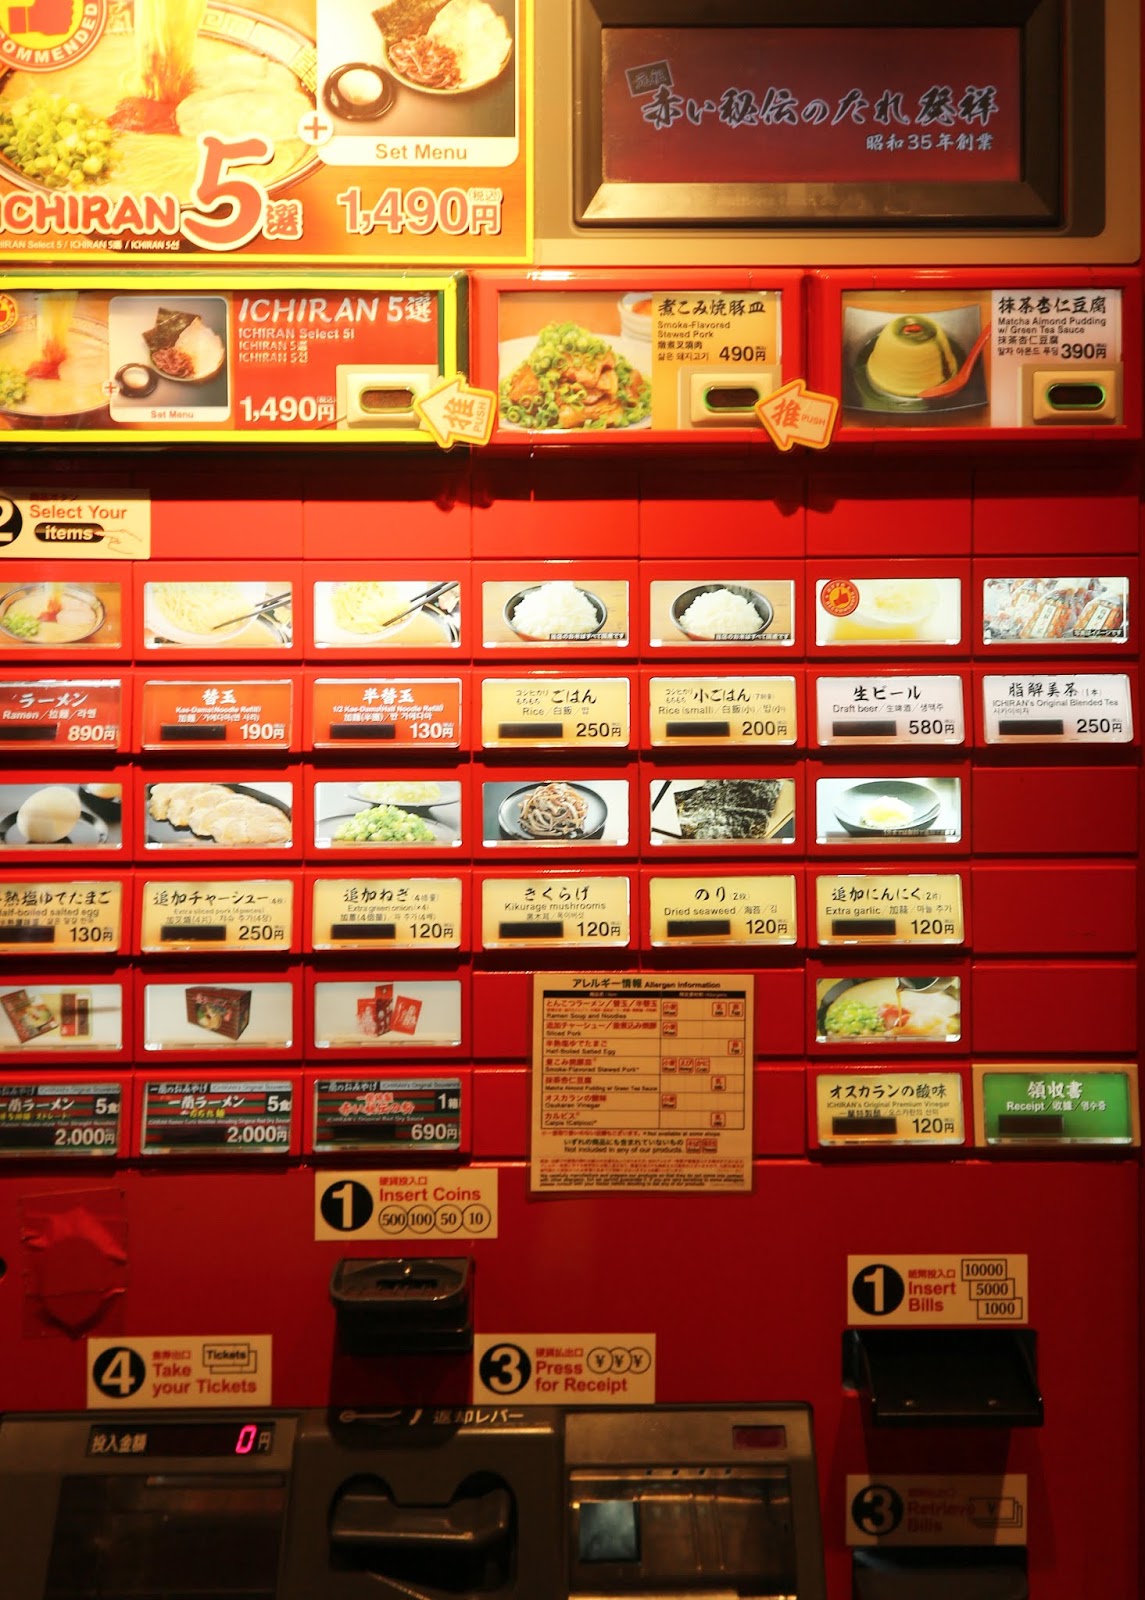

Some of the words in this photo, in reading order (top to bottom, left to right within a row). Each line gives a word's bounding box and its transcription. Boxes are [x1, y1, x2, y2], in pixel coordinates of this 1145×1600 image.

[865, 133, 994, 151] 昭和35年創業
[376, 143, 408, 160] Set
[415, 143, 467, 160] Menu
[0, 192, 180, 234] CHIRAN
[337, 186, 502, 235] 1,490円
[28, 240, 54, 249] Select
[238, 297, 379, 323] ICHIRAN
[387, 294, 432, 323] 5選
[658, 298, 767, 317] 煮こみ焼豚皿
[998, 296, 1106, 314] 抹茶杏仁豆腐
[658, 321, 731, 329] Smoke-Flavored
[998, 317, 1030, 325] Matcha
[1032, 317, 1067, 326] Almond
[1069, 317, 1106, 327] Pudding
[238, 328, 295, 339] ICHIRAN
[299, 328, 340, 339] Select
[1010, 326, 1037, 334] Green
[1040, 326, 1055, 334] Tea
[1057, 326, 1085, 334] Sauce
[239, 341, 287, 351] ICHIRAN
[719, 345, 766, 361] 490円
[1061, 343, 1107, 359] 390円
[239, 352, 287, 363] ICHIRAN
[151, 411, 166, 419] Set
[169, 411, 194, 419] Menu
[239, 395, 335, 422] 1,490円
[771, 399, 801, 429] 推
[473, 402, 487, 433] PUSH
[800, 414, 826, 426] PUSH
[30, 504, 82, 519] Select
[88, 505, 128, 519] Your
[45, 525, 94, 540] items
[19, 692, 88, 708] ラーメン
[202, 688, 237, 705] 替玉
[362, 687, 415, 705] 半替玉
[551, 689, 597, 704] ごはん
[693, 688, 750, 703] 小ごはん
[853, 685, 921, 701] 生ビール
[522, 707, 545, 716] Rice
[658, 706, 680, 715] Rice
[682, 705, 714, 714] (small)
[833, 704, 855, 713] Draft
[858, 704, 878, 713] beer
[1036, 700, 1068, 708] Original
[2, 710, 39, 719] Ramen
[67, 725, 115, 741] 890円
[240, 723, 284, 740] 190円
[410, 722, 453, 739] 130円
[576, 722, 621, 737] 250円
[742, 721, 787, 736] 200円
[909, 720, 955, 735] 580円
[1077, 719, 1122, 733] 250円
[0, 890, 112, 907] 熟塩ゆでたまご
[153, 890, 268, 906] 追加チャーシュー
[343, 887, 409, 903] 追加ねぎ
[524, 886, 590, 901] きくらげ
[695, 886, 725, 901] のり
[832, 887, 921, 902] 追加にんにく
[81, 910, 99, 918] egg
[368, 905, 390, 913] green
[505, 903, 547, 911] Kikurage
[550, 902, 606, 910] mushrooms
[664, 907, 690, 916] Dried
[693, 907, 736, 915] seaweed
[826, 907, 851, 915] Extra
[854, 907, 880, 916] garlic
[70, 927, 113, 942] 130円
[239, 926, 284, 940] 250円
[410, 923, 453, 938] 120円
[577, 922, 620, 937] 120円
[746, 920, 788, 934] 120円
[911, 920, 954, 934] 120円
[572, 978, 642, 988] アレルギー情報
[830, 1084, 947, 1099] オスカランの酸味
[1028, 1081, 1083, 1099] 領収書
[924, 1101, 950, 1109] Vinegar
[1007, 1102, 1045, 1112] Receipt
[412, 1123, 457, 1140] 690円
[913, 1118, 954, 1134] 120円
[55, 1128, 115, 1145] 2,000円
[227, 1126, 287, 1143] 2,000円
[379, 1188, 428, 1202] Insert
[433, 1187, 481, 1201] Coins
[332, 1183, 354, 1229] 1
[382, 1214, 406, 1226] 500
[410, 1214, 433, 1226] 100
[440, 1213, 457, 1225] 50
[469, 1213, 483, 1225] 10
[965, 1263, 1004, 1277] 10000
[863, 1267, 885, 1313] 1
[908, 1281, 957, 1295] Insert
[976, 1283, 1009, 1296] 5000
[908, 1298, 944, 1312] Bills
[984, 1302, 1016, 1315] 1000
[206, 1350, 247, 1360] Tickets
[101, 1350, 136, 1395] 4
[153, 1363, 192, 1377] Take
[490, 1347, 522, 1392] 3
[536, 1361, 583, 1375] Press
[153, 1383, 190, 1398] your
[197, 1379, 257, 1394] Tickets
[535, 1378, 560, 1392] for
[564, 1378, 628, 1395] Receipt
[91, 1432, 148, 1453] 投入金額
[235, 1424, 258, 1454] 0
[862, 1488, 893, 1533] 3
